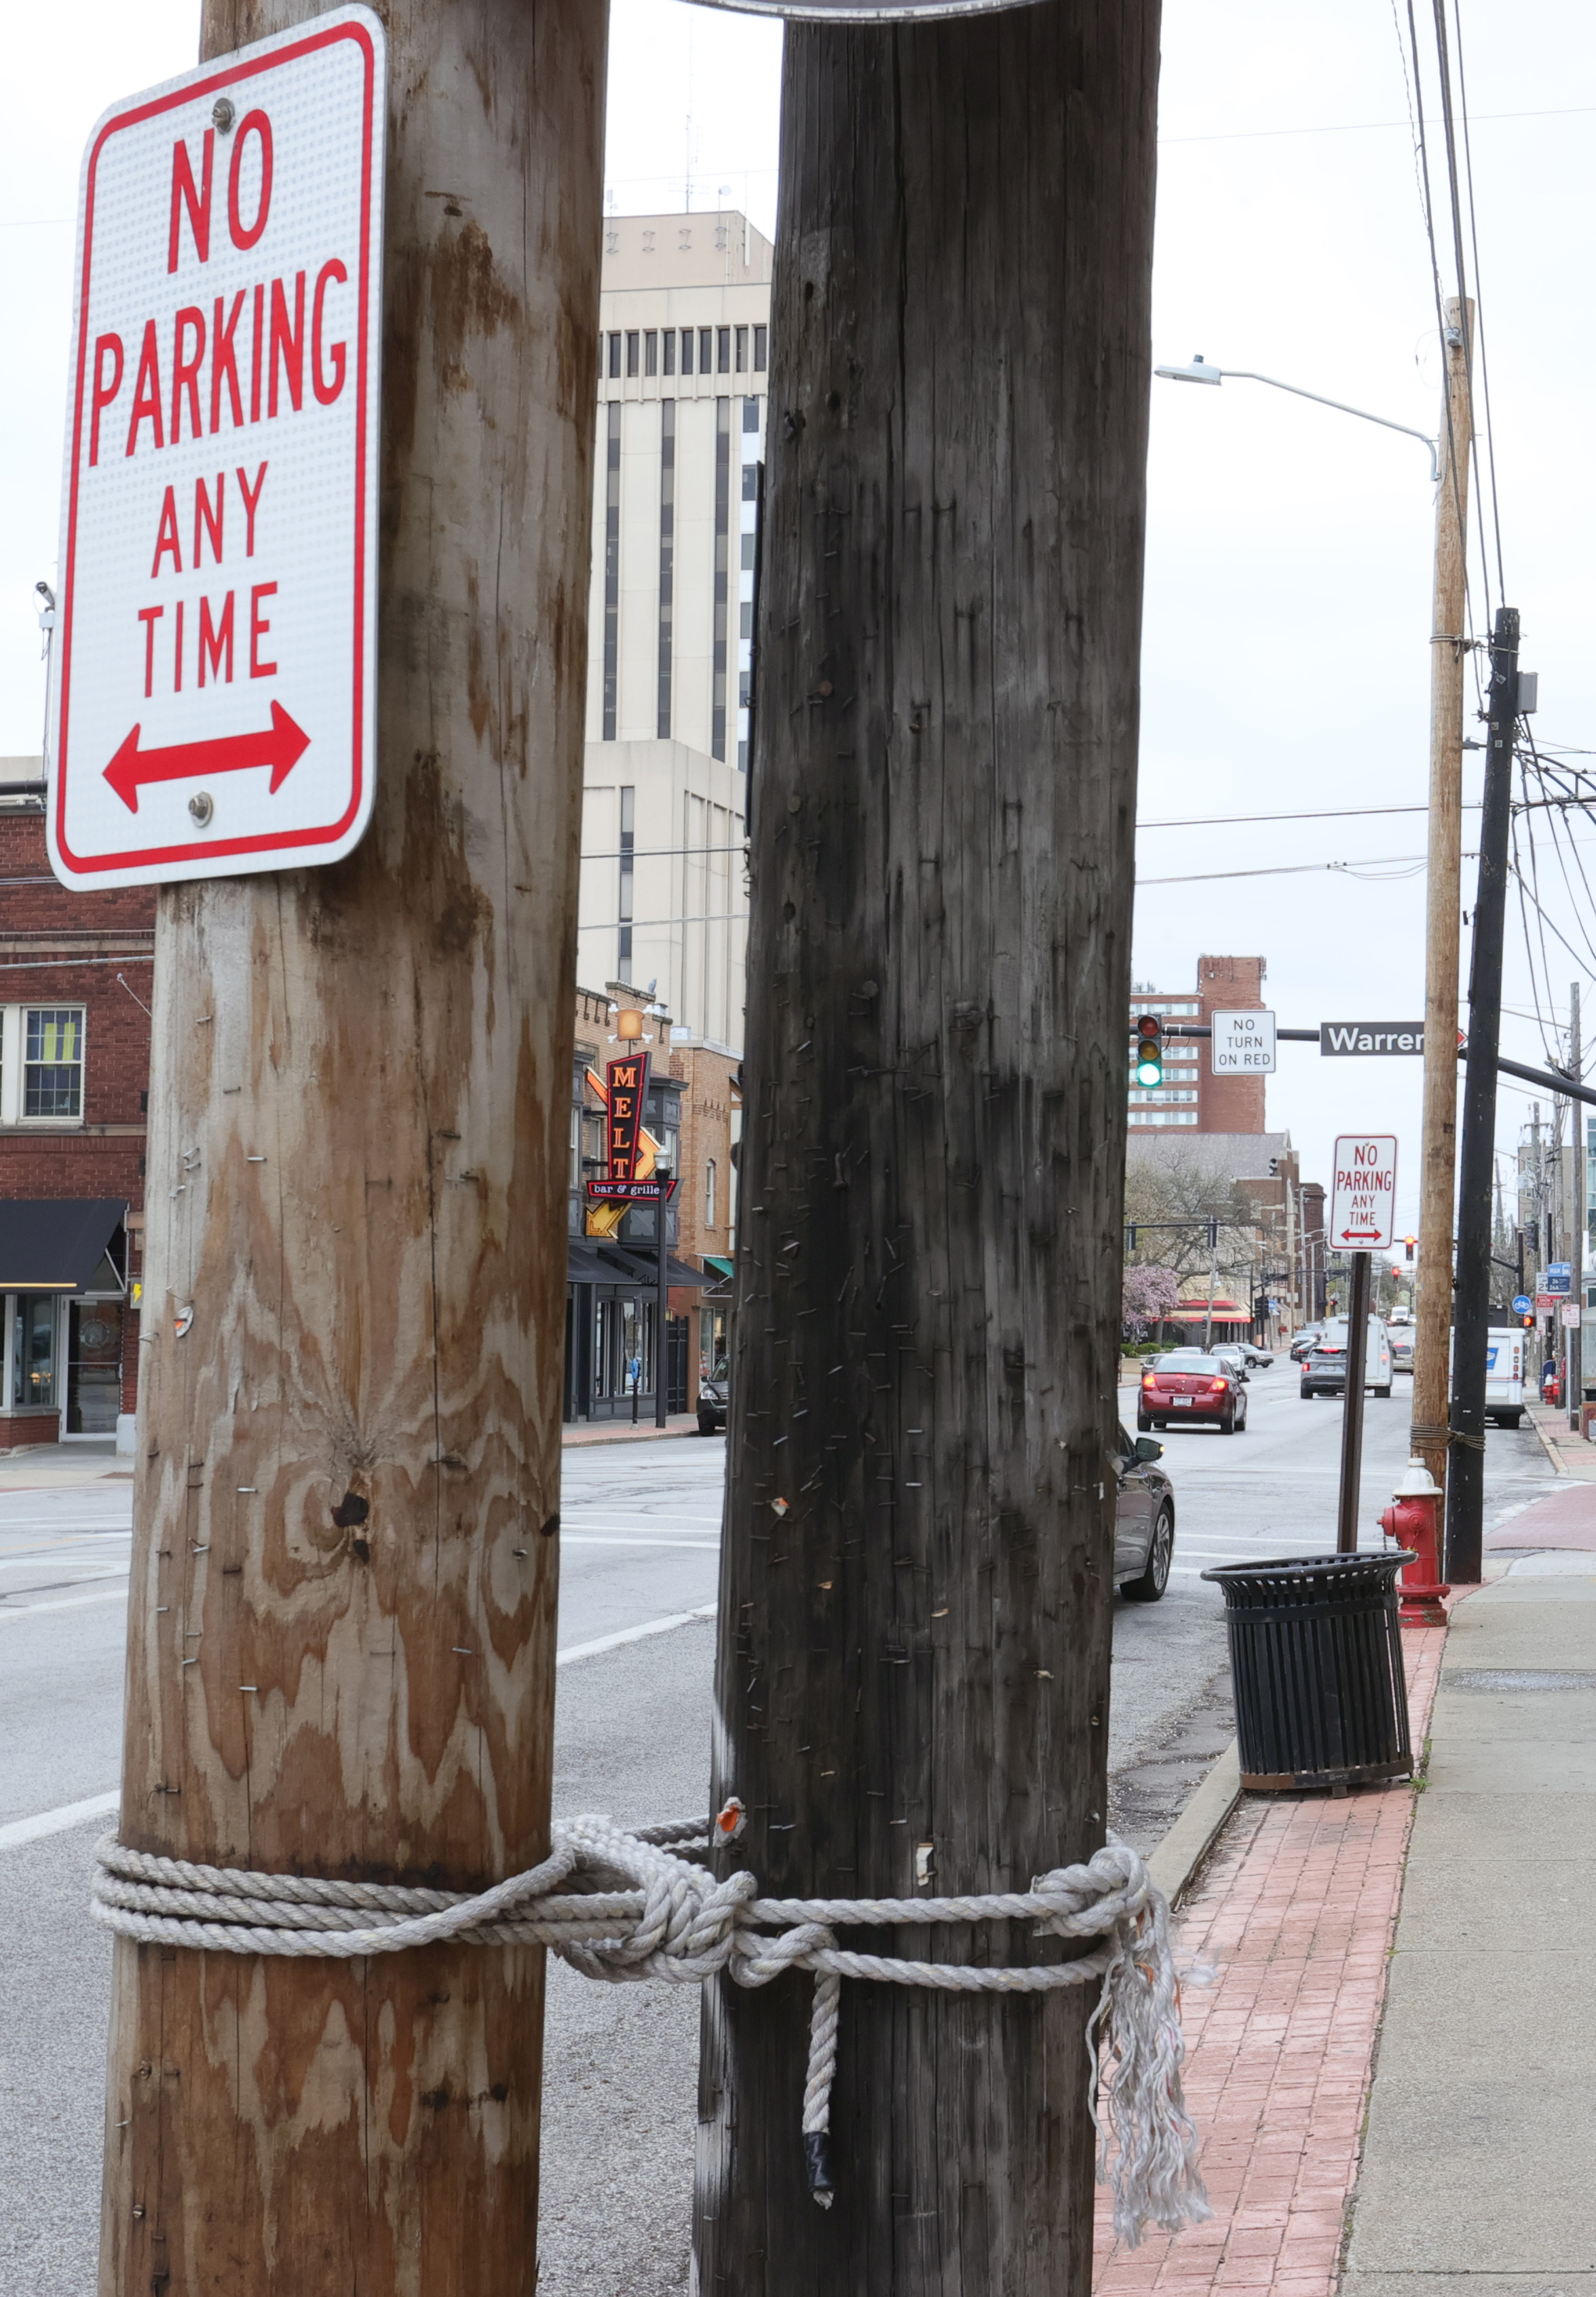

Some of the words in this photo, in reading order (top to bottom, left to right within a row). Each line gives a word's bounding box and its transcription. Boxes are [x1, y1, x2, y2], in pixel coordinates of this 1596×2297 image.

[167, 109, 272, 275] NO
[89, 258, 348, 467] PARKING
[151, 460, 269, 578] ANY
[138, 580, 278, 698] TIME
[1234, 1019, 1255, 1031] NO
[1227, 1037, 1263, 1048] TURN
[1219, 1054, 1237, 1065] ON
[1244, 1054, 1270, 1065] RED
[612, 1067, 636, 1179] MELT
[1354, 1145, 1378, 1166] NO
[594, 1184, 613, 1193] bar
[617, 1185, 626, 1194] &
[630, 1185, 660, 1195] grille
[1337, 1171, 1392, 1191] PARKING
[1351, 1195, 1375, 1208] ANY
[1350, 1212, 1376, 1226] TIME
